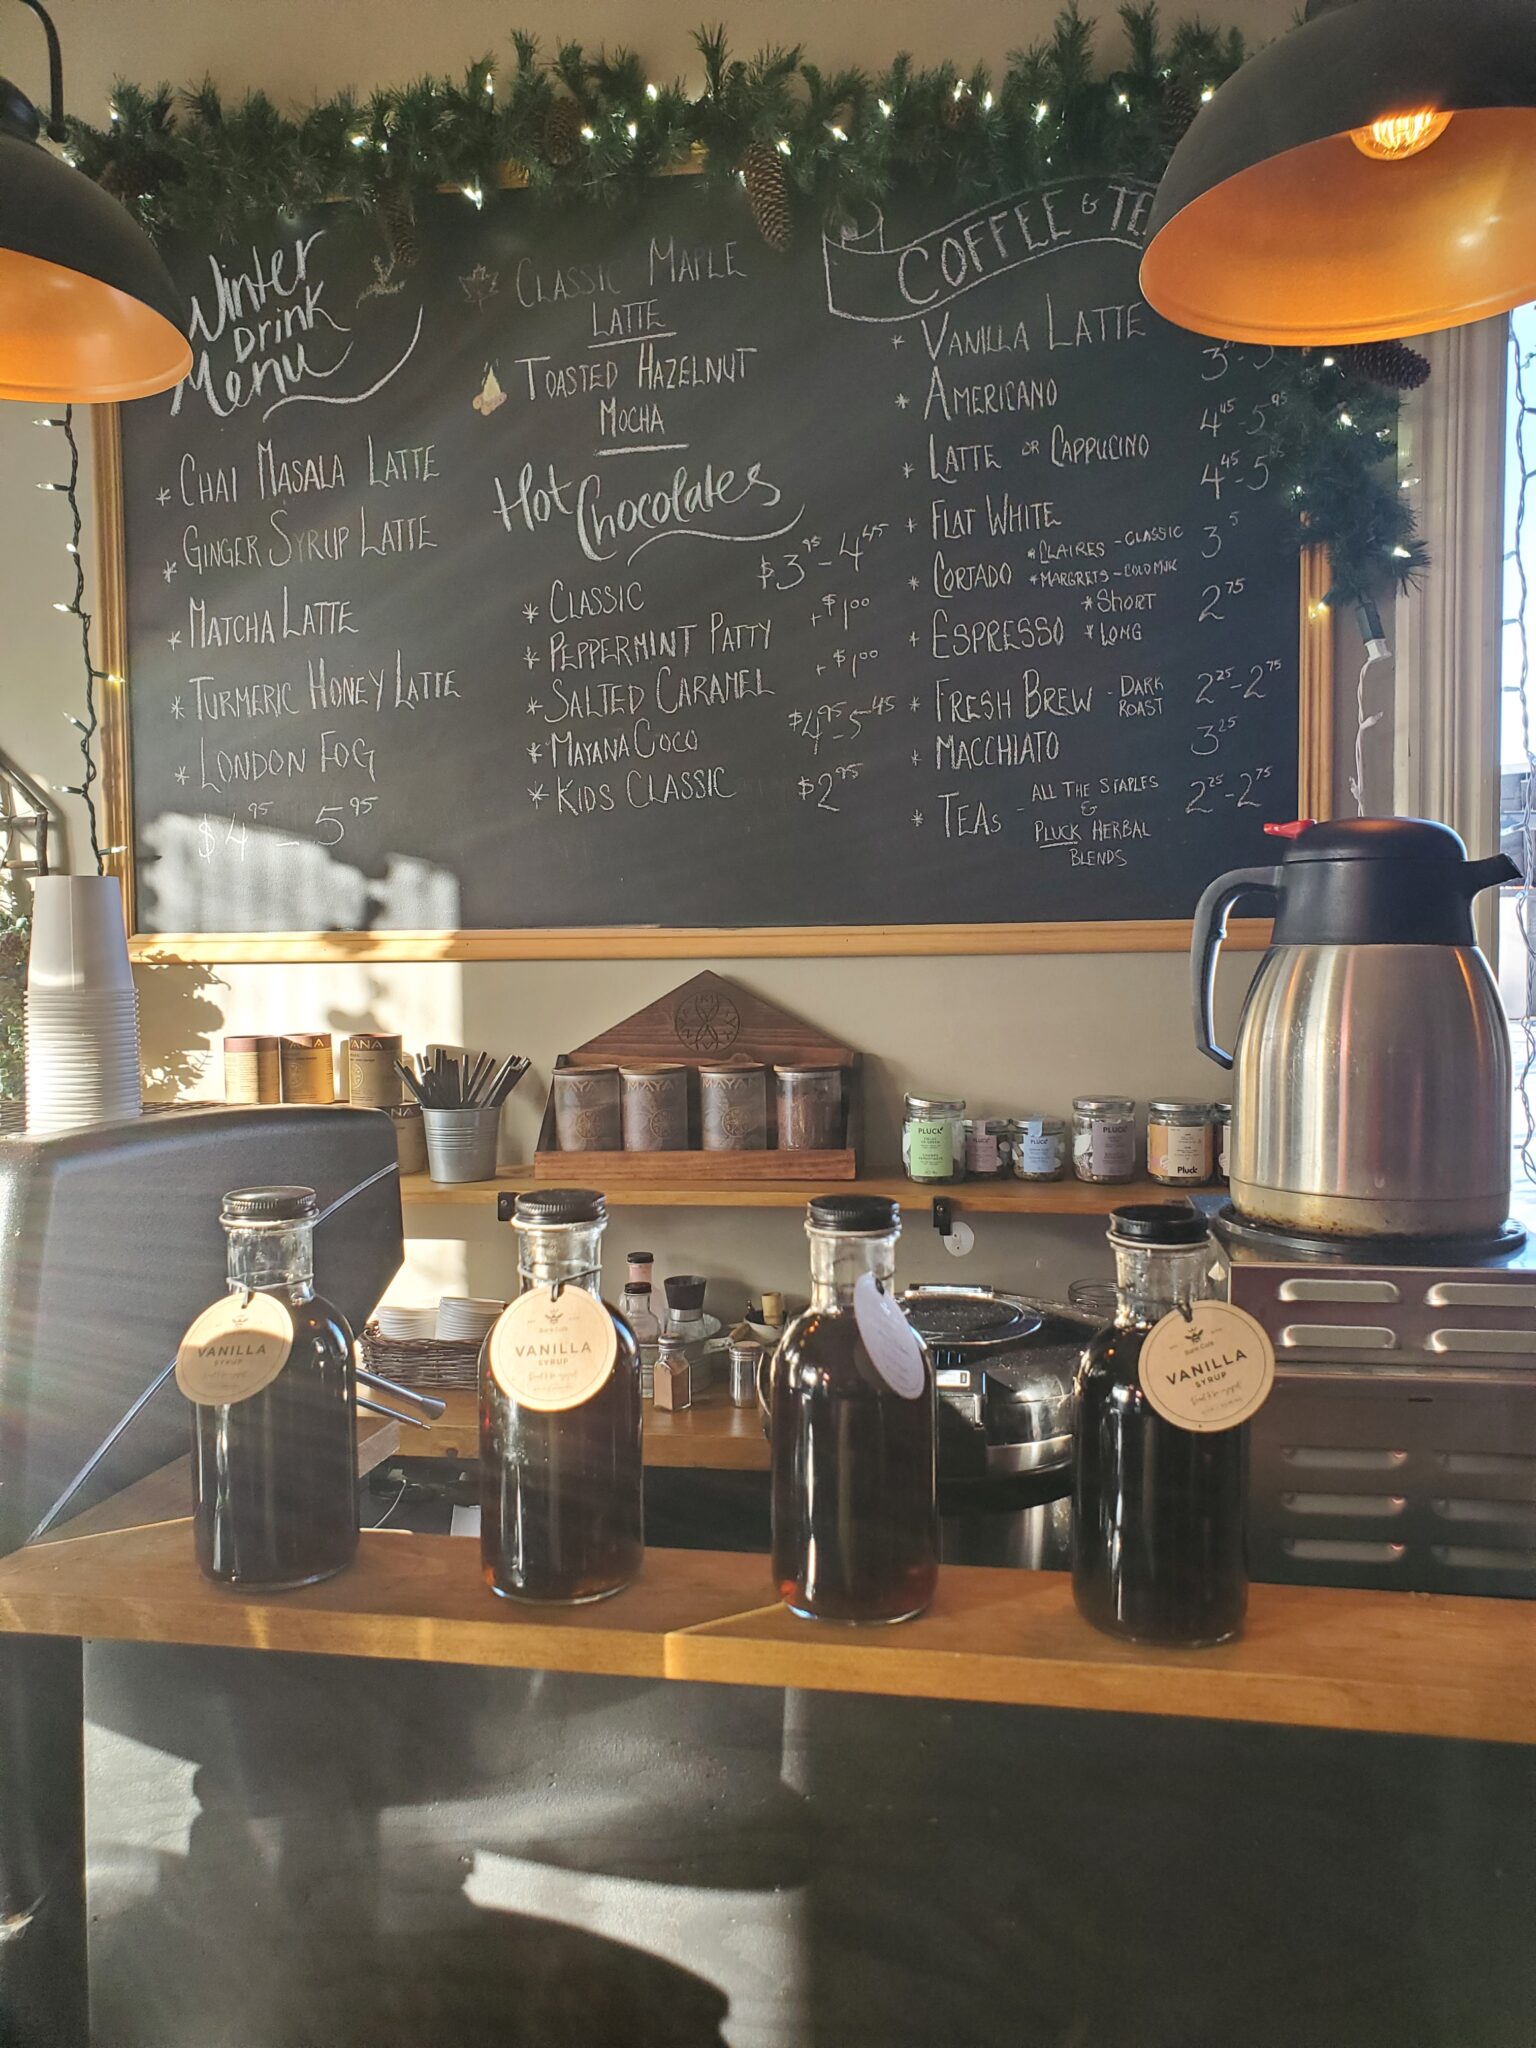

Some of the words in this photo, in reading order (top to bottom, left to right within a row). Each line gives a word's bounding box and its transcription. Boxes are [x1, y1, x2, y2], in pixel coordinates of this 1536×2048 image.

[898, 188, 1073, 305] COFFEE
[1108, 185, 1155, 237] TE
[516, 257, 622, 308] CLASSIC
[592, 298, 666, 337] LATTE
[921, 311, 1030, 361] VANILLA
[1046, 293, 1146, 350] LATTE
[170, 341, 353, 417] Menu
[514, 355, 619, 400] TOASTED
[639, 341, 758, 390] HAZELNUT
[923, 365, 1058, 421] AMERICANO
[600, 396, 665, 437] MOCHA
[180, 453, 238, 507] CHAI
[257, 439, 345, 500] MASALA
[368, 434, 440, 488] LATTE
[929, 434, 1002, 484] LATTE
[1051, 425, 1150, 467] CAPPUCINO
[493, 462, 574, 532] Hot
[577, 462, 781, 561] Chocolates
[932, 499, 976, 540] FLAT
[986, 493, 1062, 537] WHITE
[183, 525, 262, 575] GINGER
[269, 509, 350, 567] SYRUP
[361, 505, 437, 558] LATTE
[933, 550, 1012, 598] CORTADO
[189, 597, 275, 649] MATCHA
[283, 585, 359, 639] LATTE
[550, 579, 645, 624] CLASSIC
[549, 624, 698, 672] PEPPERMINT
[710, 611, 772, 654] PATTY
[932, 609, 1064, 659] ESPRESSO
[1100, 622, 1142, 647] LONG
[189, 676, 300, 721] TURMERIC
[308, 657, 384, 712] HONEY
[394, 649, 462, 710] LATTE
[544, 678, 644, 723] SALTED
[656, 665, 776, 714] CARAMEL
[936, 678, 1011, 723] FRESH
[1023, 669, 1093, 720] BREW
[1119, 675, 1164, 697] DARK
[1118, 698, 1164, 717] ROAST
[201, 737, 306, 793] LONDON
[321, 730, 376, 782] FOG
[549, 730, 630, 768] MAYANA
[634, 718, 698, 758] COCO
[936, 731, 1060, 770] MACCHIATO
[557, 776, 615, 816] KIDS
[626, 767, 737, 808] CLASSIC
[1032, 782, 1056, 802] ALL
[1062, 780, 1090, 798] THE
[1100, 775, 1159, 794] STAPLES
[1035, 820, 1082, 843] PLUCK
[1092, 819, 1151, 841] HERBAL
[1069, 848, 1128, 868] BLENDS
[918, 1127, 944, 1135] PLUCK
[1177, 1166, 1198, 1174] Pluck
[198, 1344, 266, 1357] VANILLA
[515, 1342, 592, 1357] VANILLA
[1165, 1349, 1248, 1385] VANILLA
[1195, 1372, 1227, 1388] SYRUP
